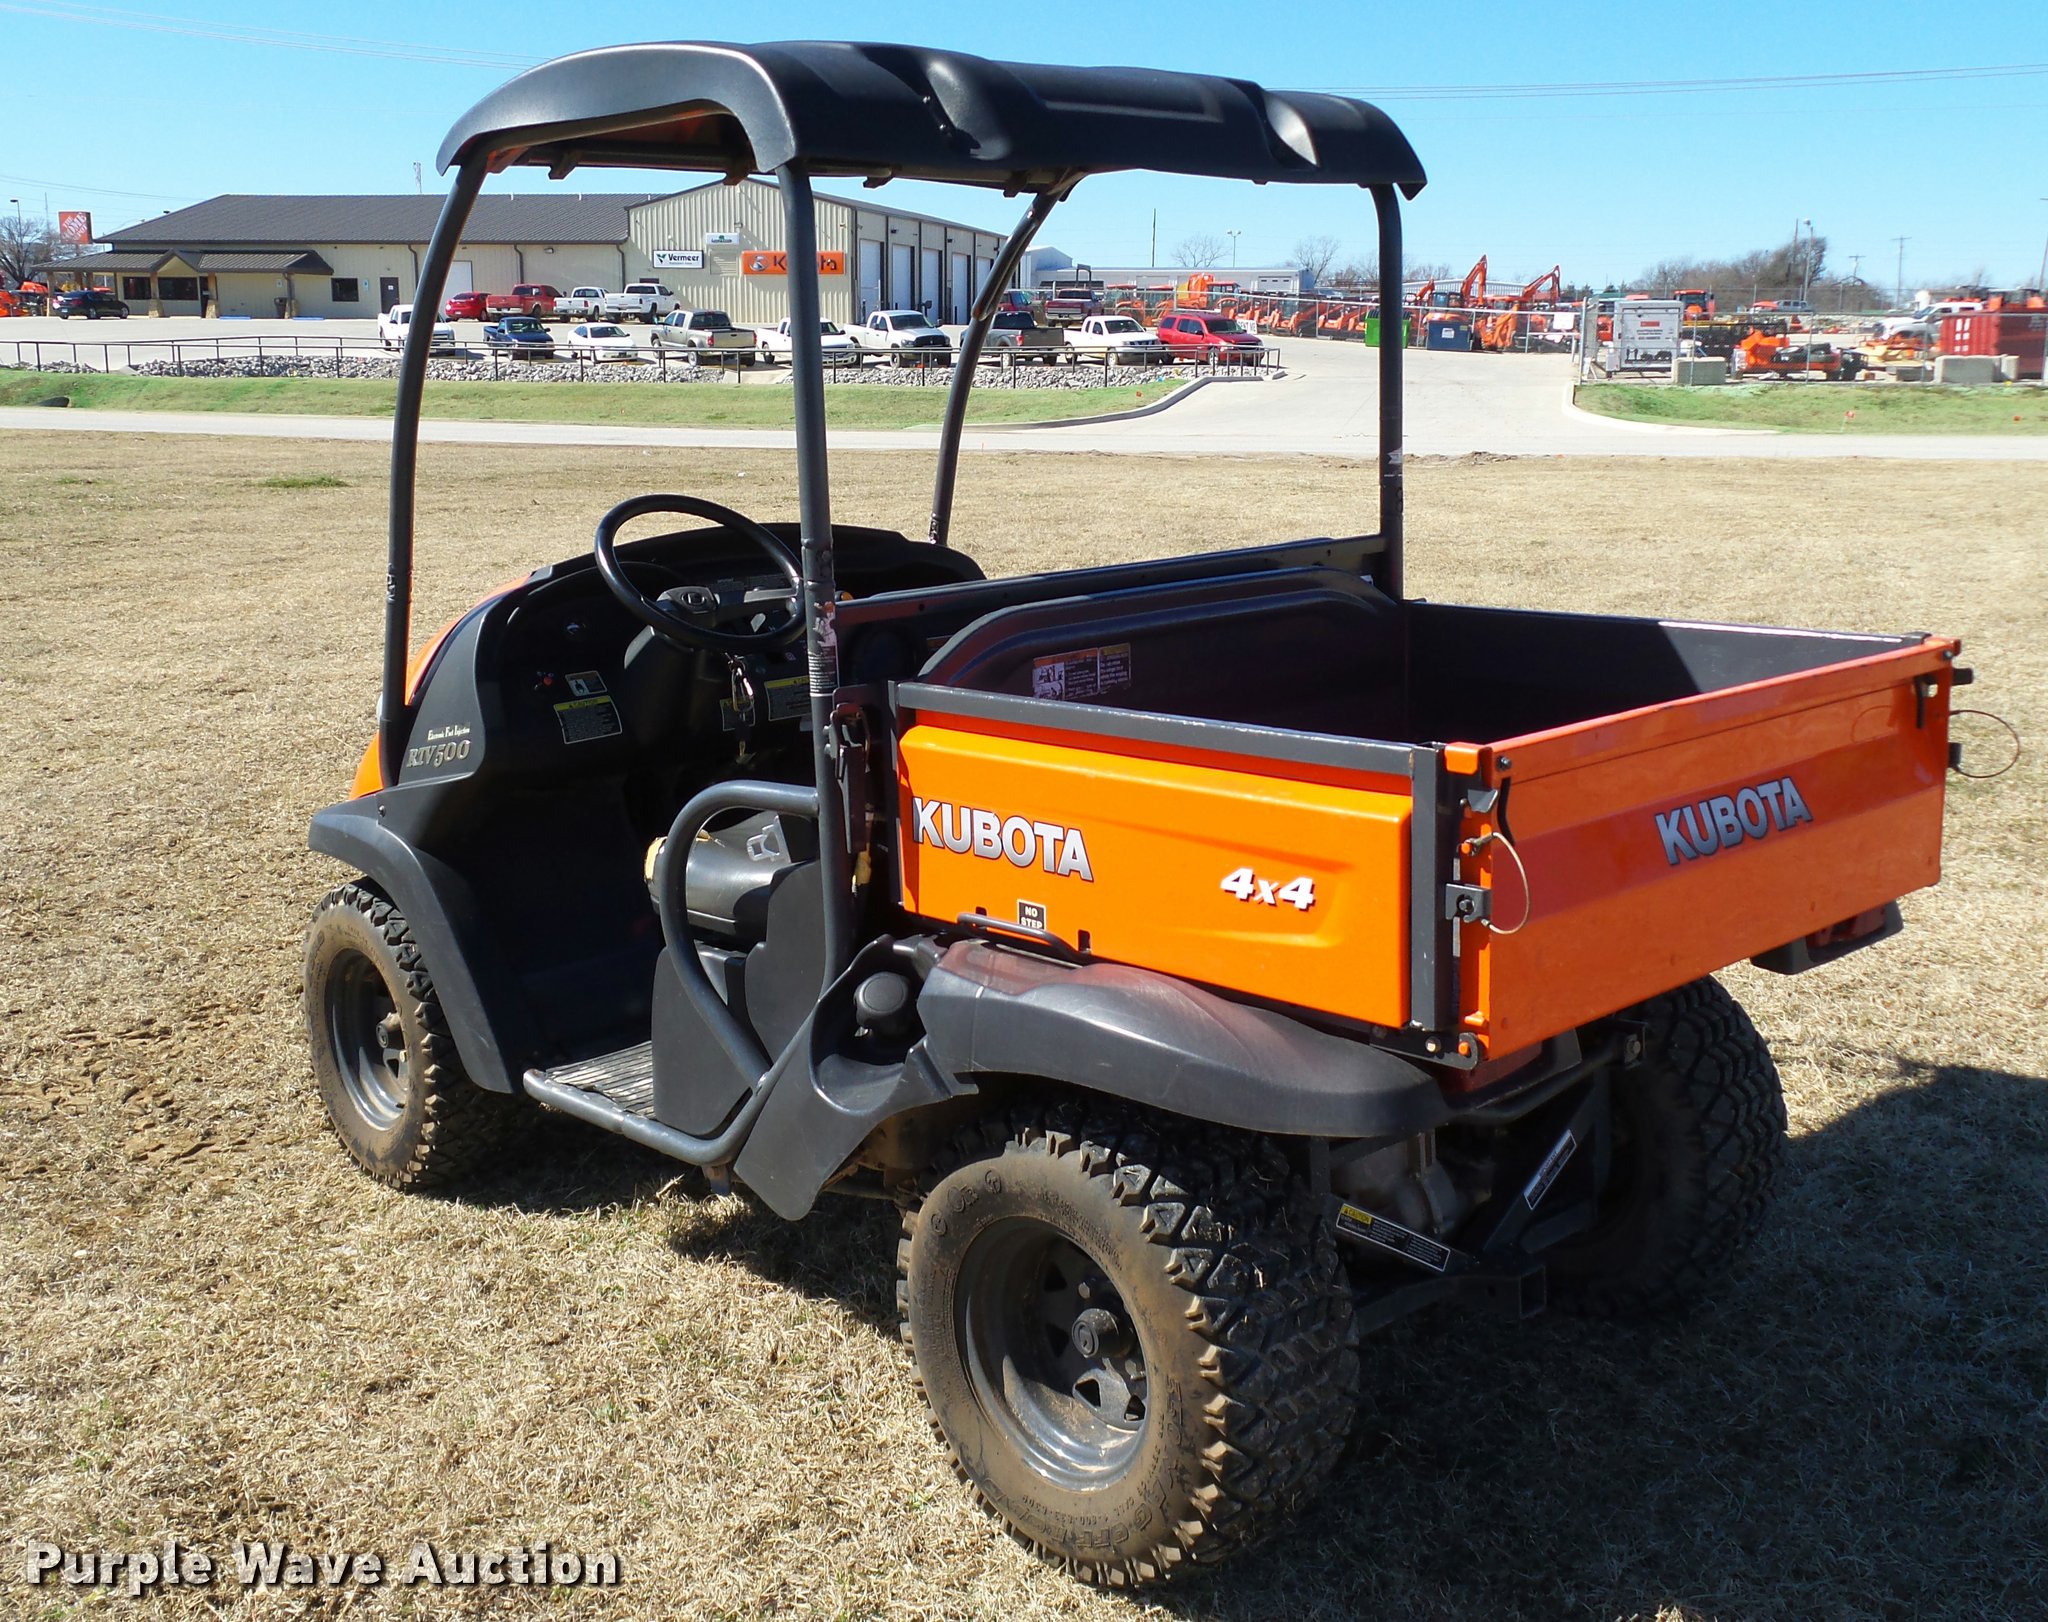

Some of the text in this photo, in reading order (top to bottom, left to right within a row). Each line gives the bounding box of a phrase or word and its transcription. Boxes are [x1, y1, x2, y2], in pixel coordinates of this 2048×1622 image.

[668, 253, 699, 262] Vermeer
[1654, 776, 1814, 866] KUBOTA
[912, 797, 1095, 882] KUBOTA
[1219, 866, 1316, 912] 4x4
[1020, 916, 1043, 929] STEP
[1024, 905, 1039, 918] NO
